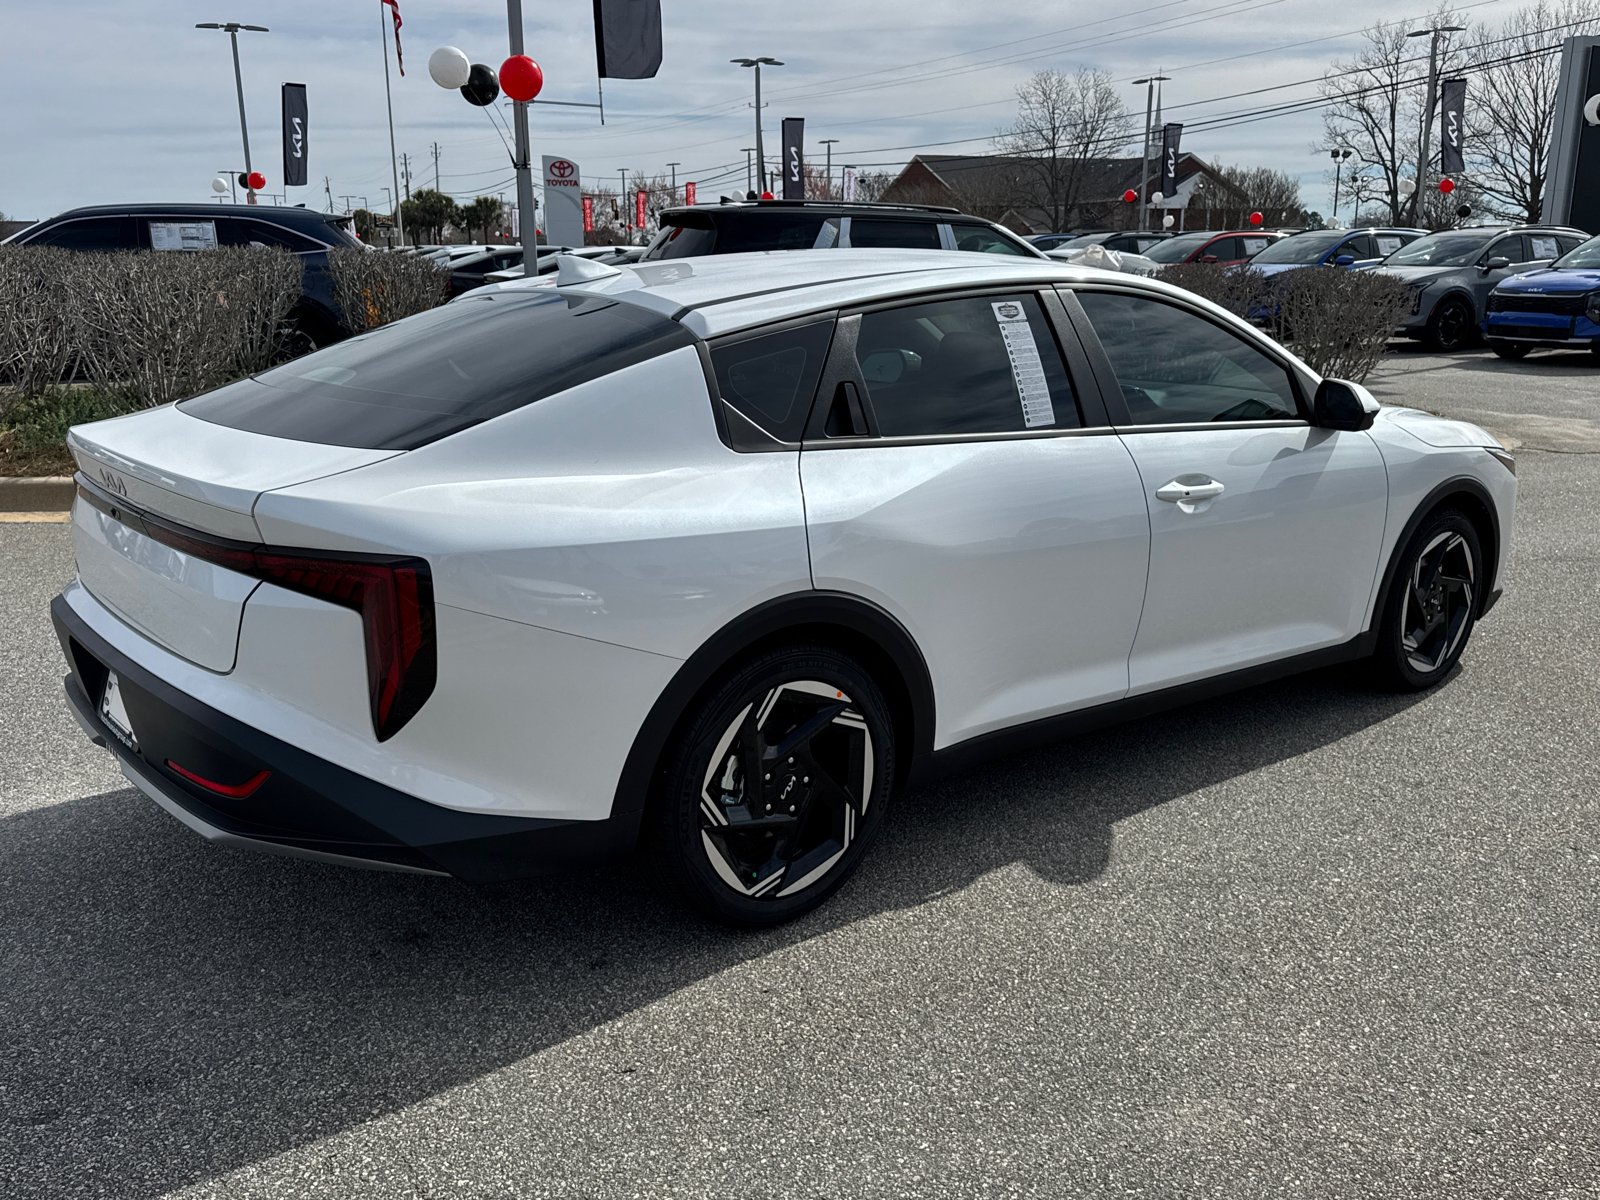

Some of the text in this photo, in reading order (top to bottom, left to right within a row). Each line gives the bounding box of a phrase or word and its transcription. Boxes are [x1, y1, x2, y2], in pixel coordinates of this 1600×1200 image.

[546, 179, 579, 187] TOYOTA
[781, 660, 807, 672] 225/45
[808, 660, 823, 668] R17
[879, 747, 892, 812] KUMHO
[681, 778, 693, 846] SOLUS
